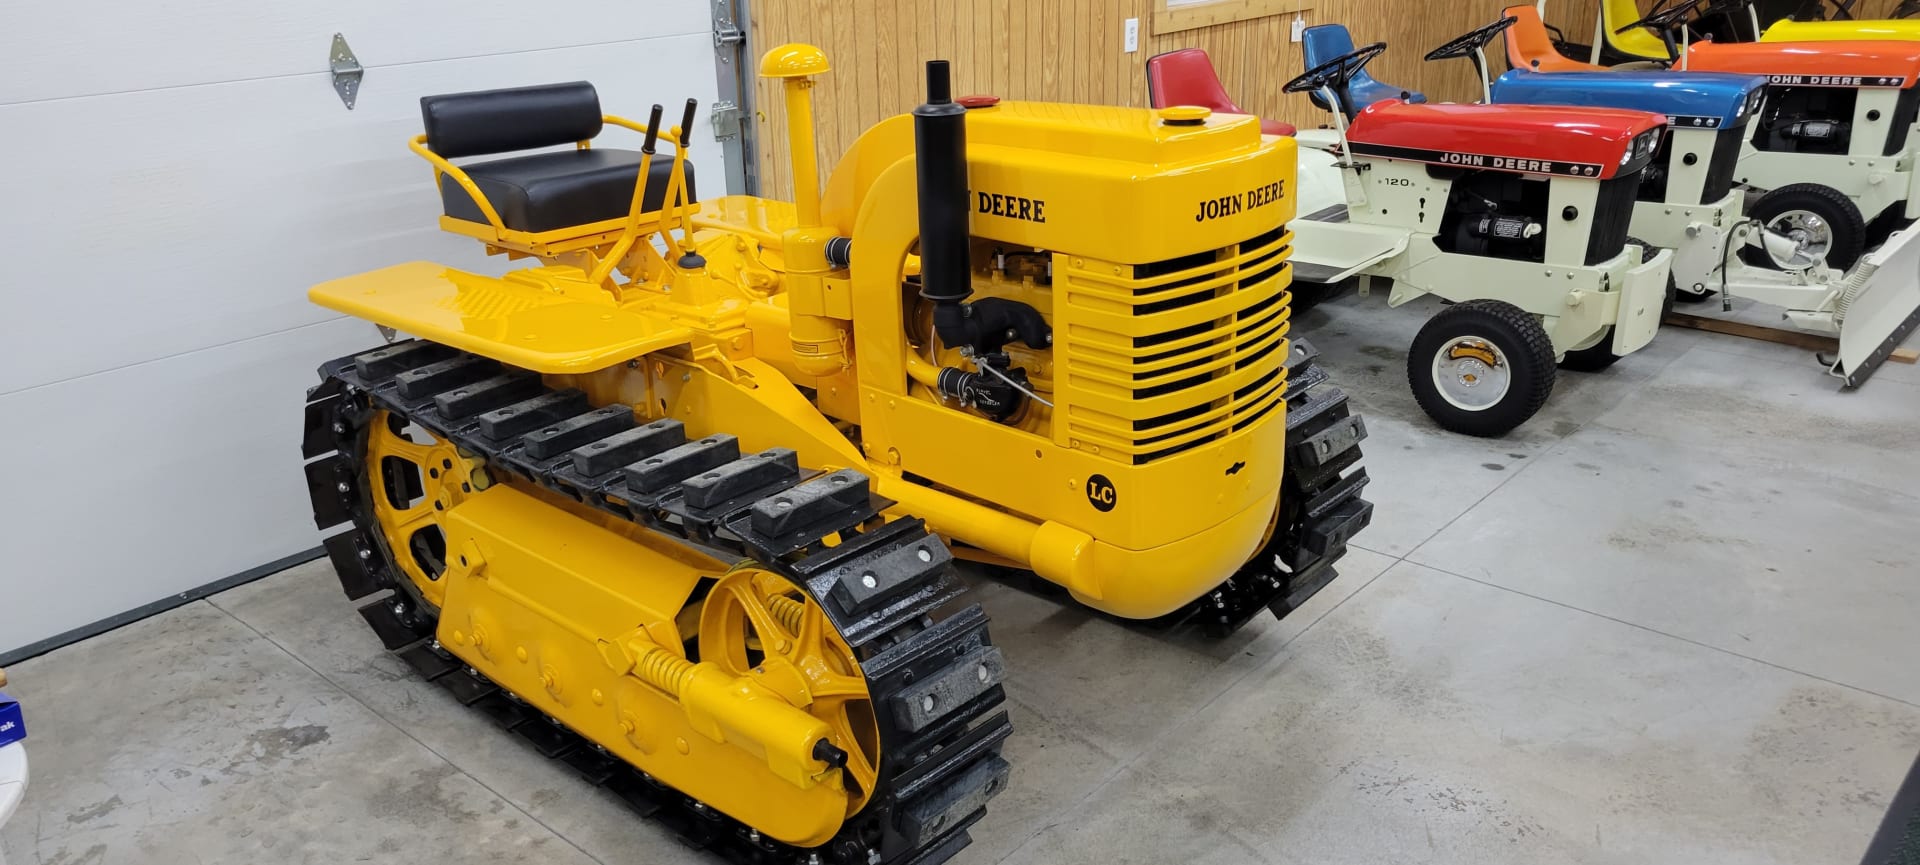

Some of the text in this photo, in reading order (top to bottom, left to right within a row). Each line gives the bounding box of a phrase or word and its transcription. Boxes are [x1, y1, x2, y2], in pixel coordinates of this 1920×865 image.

[1810, 76, 1862, 86] DEERE
[1440, 152, 1552, 173] JOHN DEERE
[1385, 177, 1409, 187] 120
[978, 191, 1046, 223] DEERE
[1195, 179, 1285, 222] JOHN DEERE
[1090, 481, 1113, 504] LC
